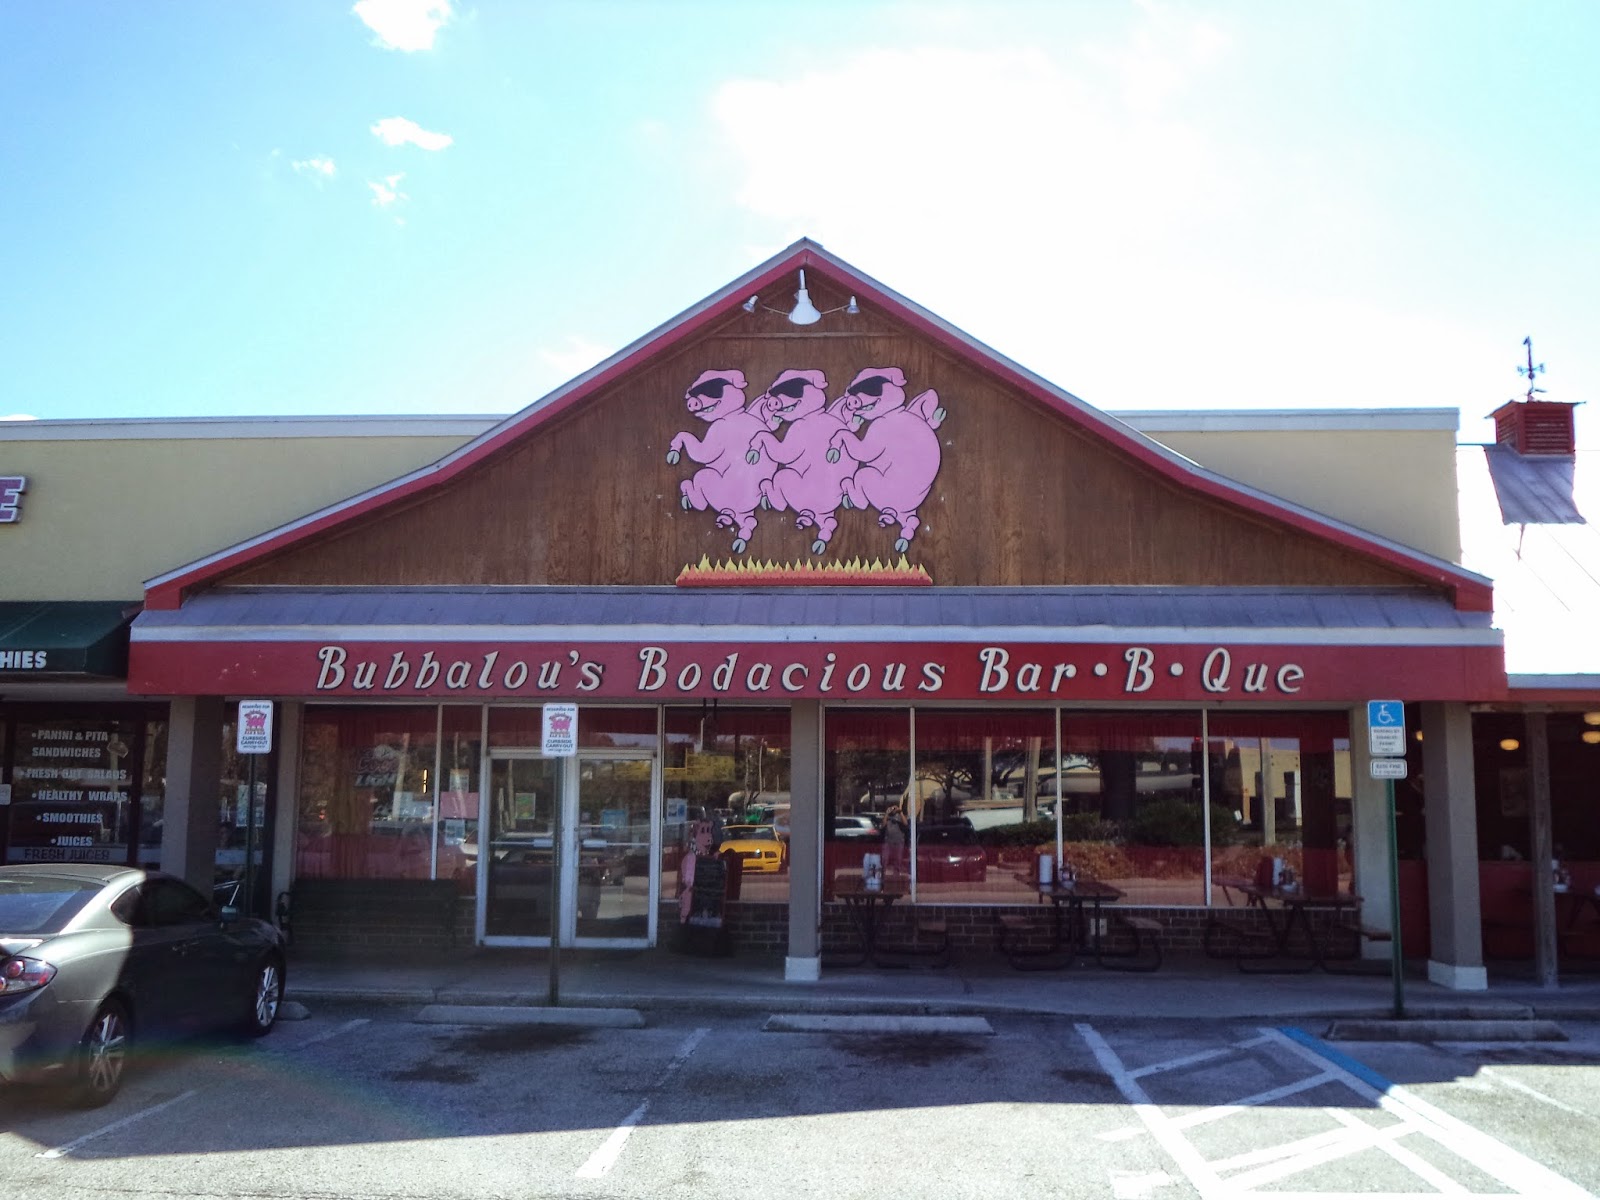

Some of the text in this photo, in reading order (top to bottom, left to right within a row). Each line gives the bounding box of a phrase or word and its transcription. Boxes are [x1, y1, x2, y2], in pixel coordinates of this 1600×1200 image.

[316, 646, 606, 691] Bubbalou's
[637, 645, 946, 692] Bodacious
[37, 730, 108, 742] PANINI & PITA
[32, 747, 101, 758] SANDWICHES
[26, 768, 58, 779] FRESH
[87, 769, 127, 780] SALADS
[38, 790, 128, 802] HEALTHY WRAPS
[42, 812, 104, 824] SMOOTHIES
[56, 836, 93, 847] JUICES
[24, 848, 110, 861] FRESH JUICES
